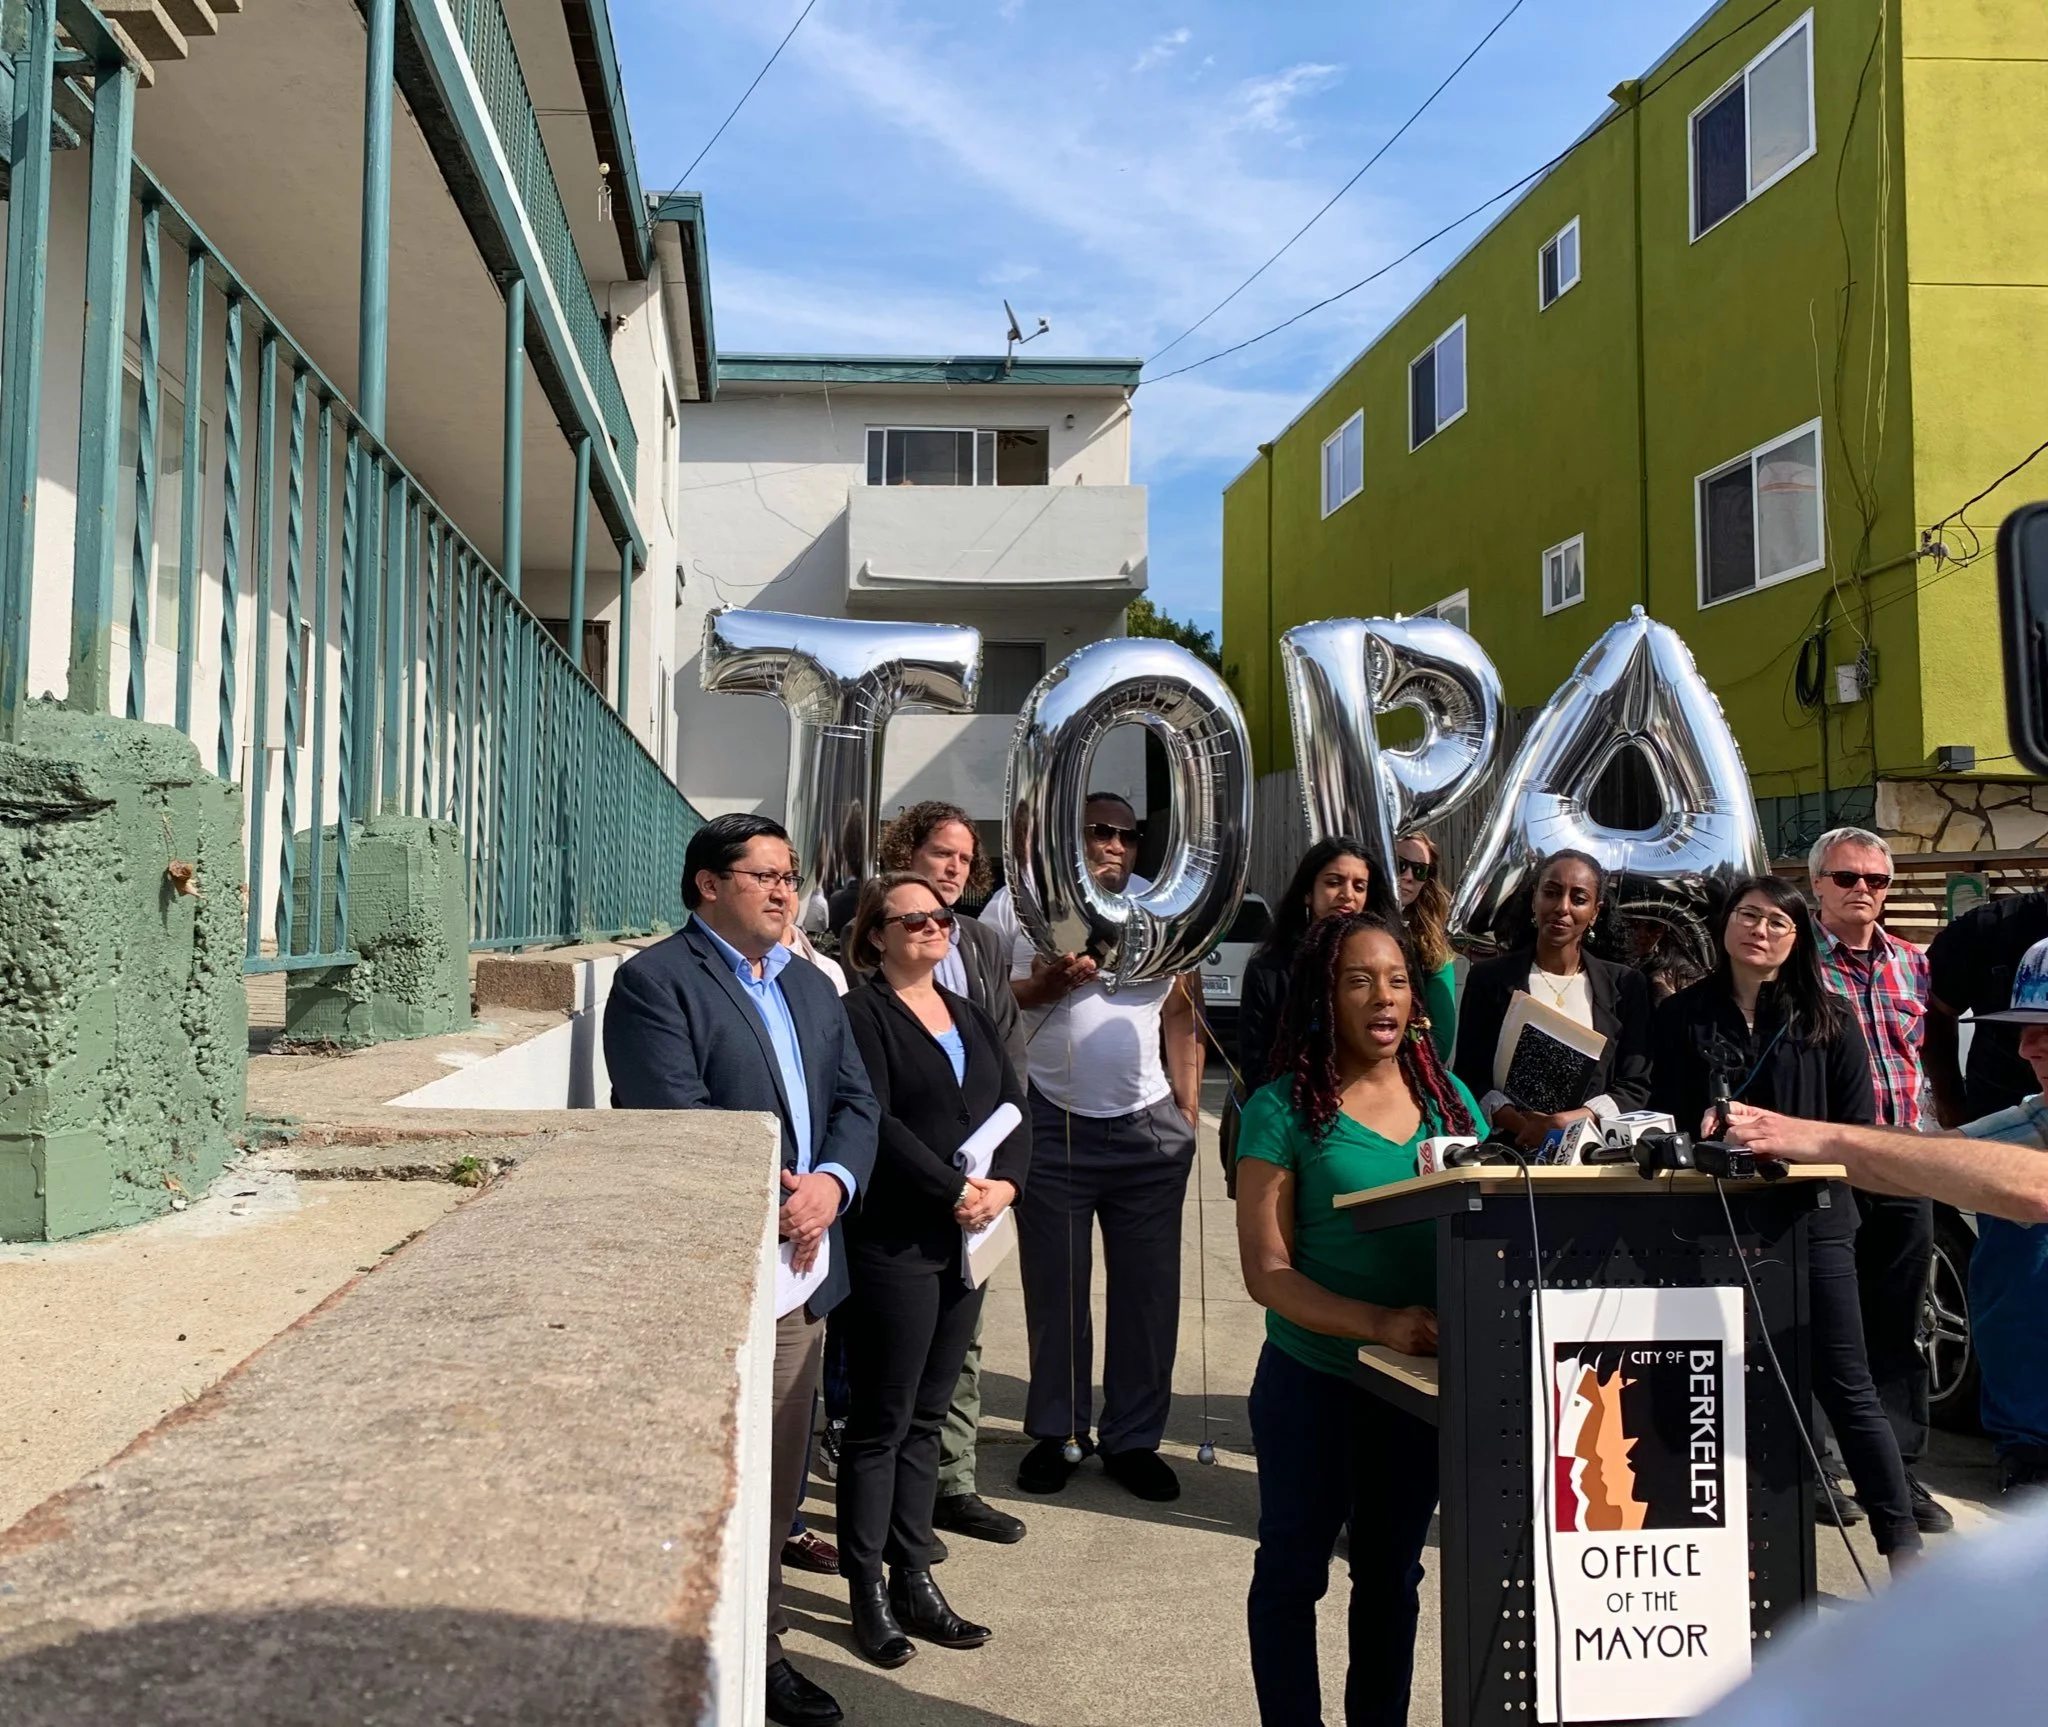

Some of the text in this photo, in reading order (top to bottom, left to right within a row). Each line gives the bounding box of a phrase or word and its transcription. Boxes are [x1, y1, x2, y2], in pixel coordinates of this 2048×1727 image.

[700, 604, 1770, 990] TOPA
[1631, 1350, 1686, 1364] CITY OF
[1689, 1349, 1718, 1522] BERKELEY
[1581, 1543, 1701, 1578] OFFICE
[1606, 1590, 1678, 1613] OF THE
[1575, 1624, 1708, 1662] MAYOR
